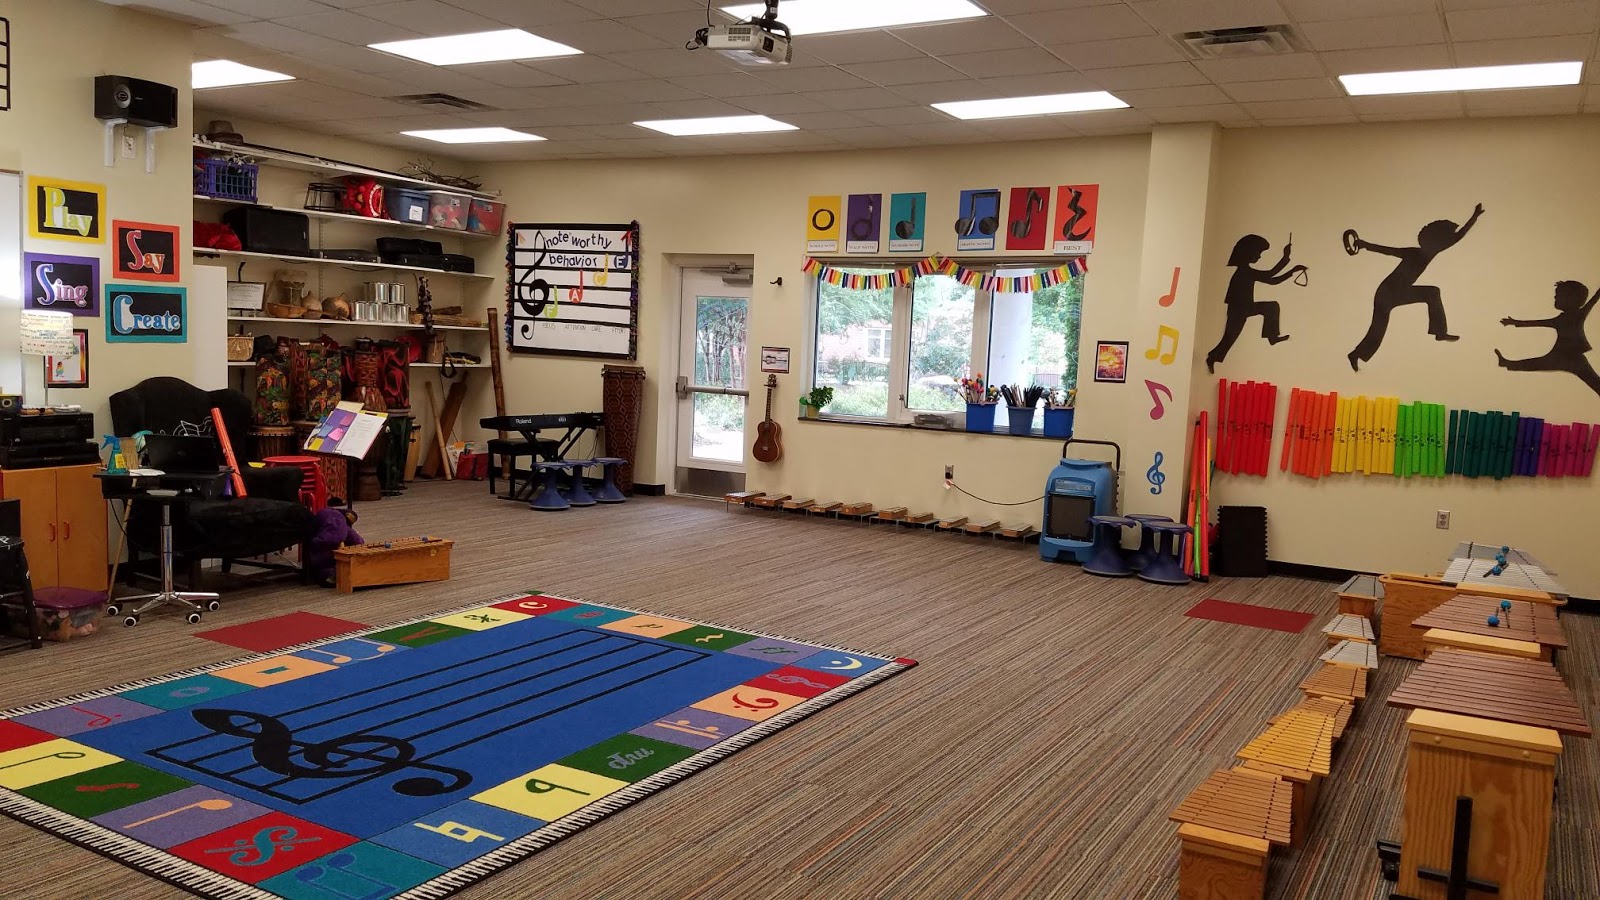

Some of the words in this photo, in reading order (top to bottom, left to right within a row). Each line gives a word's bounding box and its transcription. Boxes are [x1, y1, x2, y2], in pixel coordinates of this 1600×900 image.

[43, 186, 93, 237] Play
[126, 230, 166, 274] Say
[546, 230, 569, 248] note
[571, 233, 613, 250] worthy
[548, 253, 598, 268] behavior
[35, 263, 88, 308] Sing
[571, 289, 580, 302] A
[113, 294, 181, 334] Create
